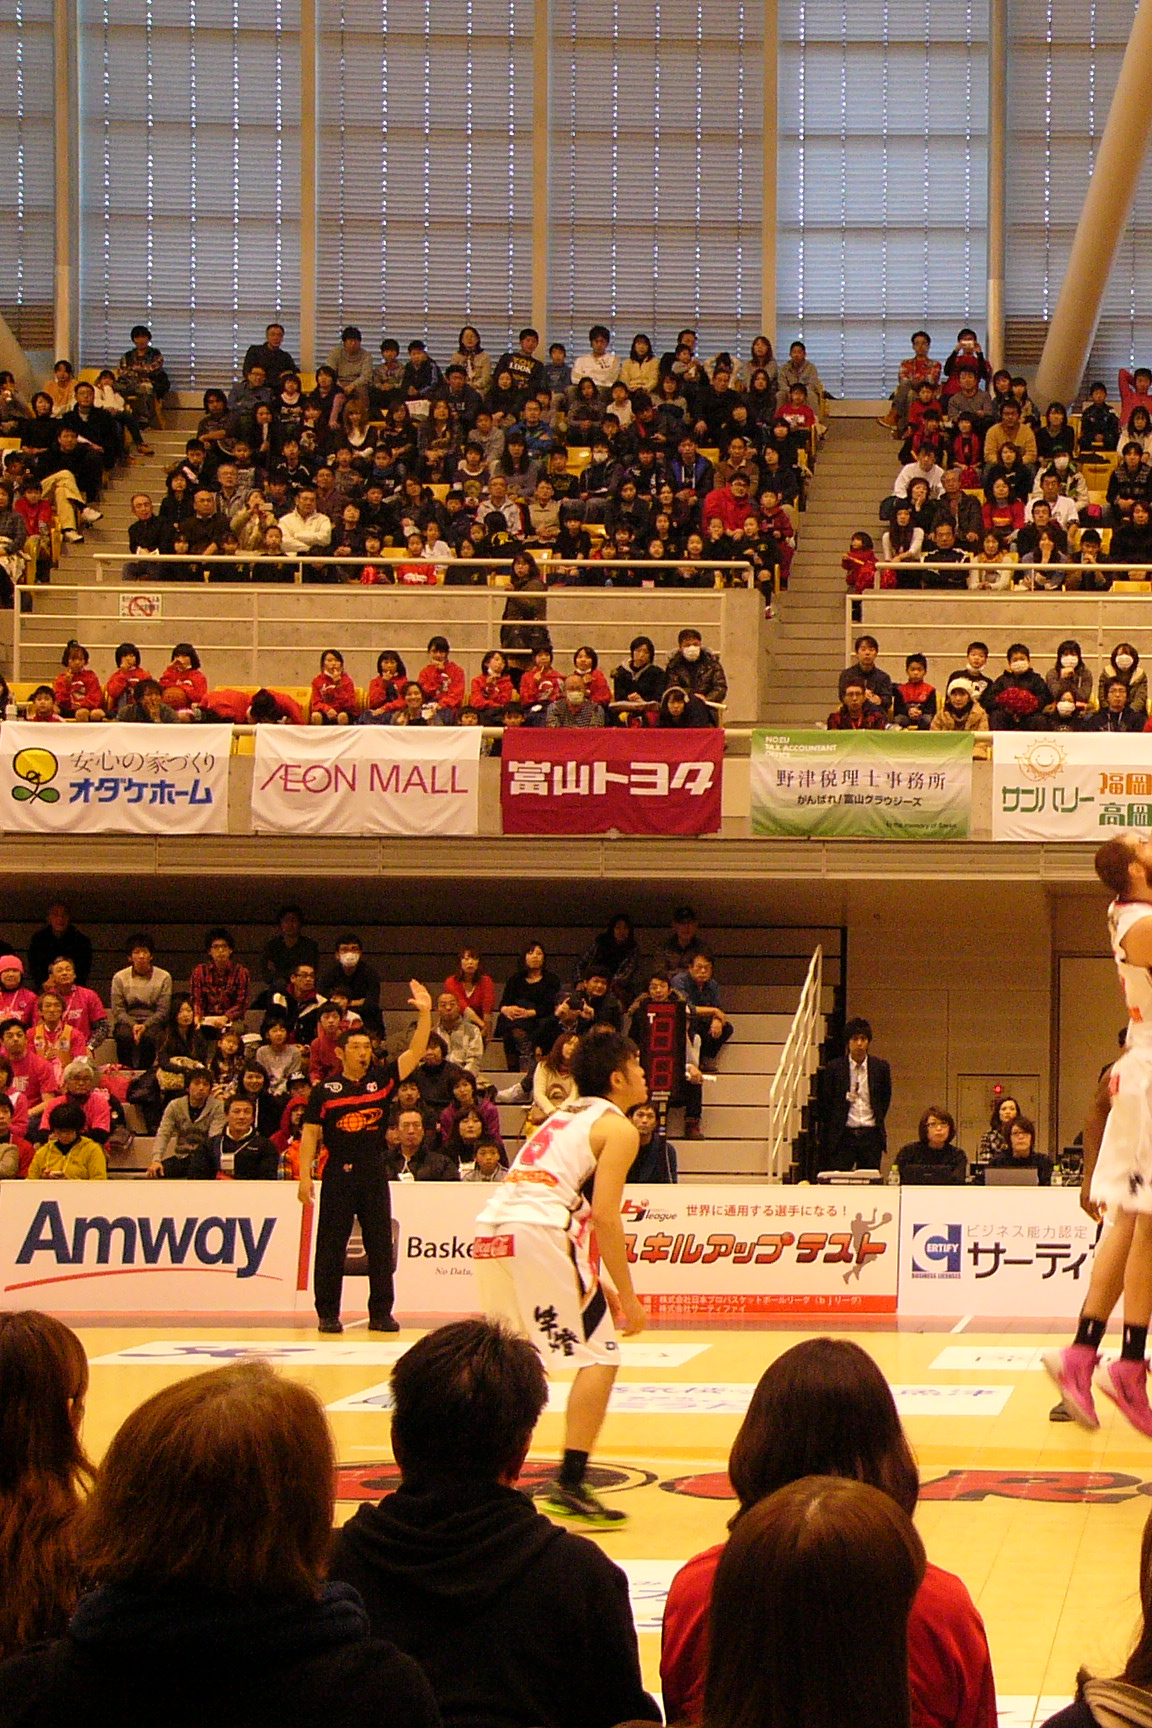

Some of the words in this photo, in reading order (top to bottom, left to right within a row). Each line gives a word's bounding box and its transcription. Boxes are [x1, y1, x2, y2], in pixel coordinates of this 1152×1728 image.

[783, 744, 837, 752] ACCOUNTANT
[69, 750, 216, 774] 安心の家づくり
[369, 764, 468, 794] MALL
[508, 760, 715, 796] 富山トヨタ
[776, 769, 946, 790] 野津税理士事務所
[69, 778, 213, 805] オダケホーム
[15, 1200, 278, 1279] Amway
[967, 1224, 1088, 1239] ビジネス能力認定
[407, 1236, 475, 1258] Baske
